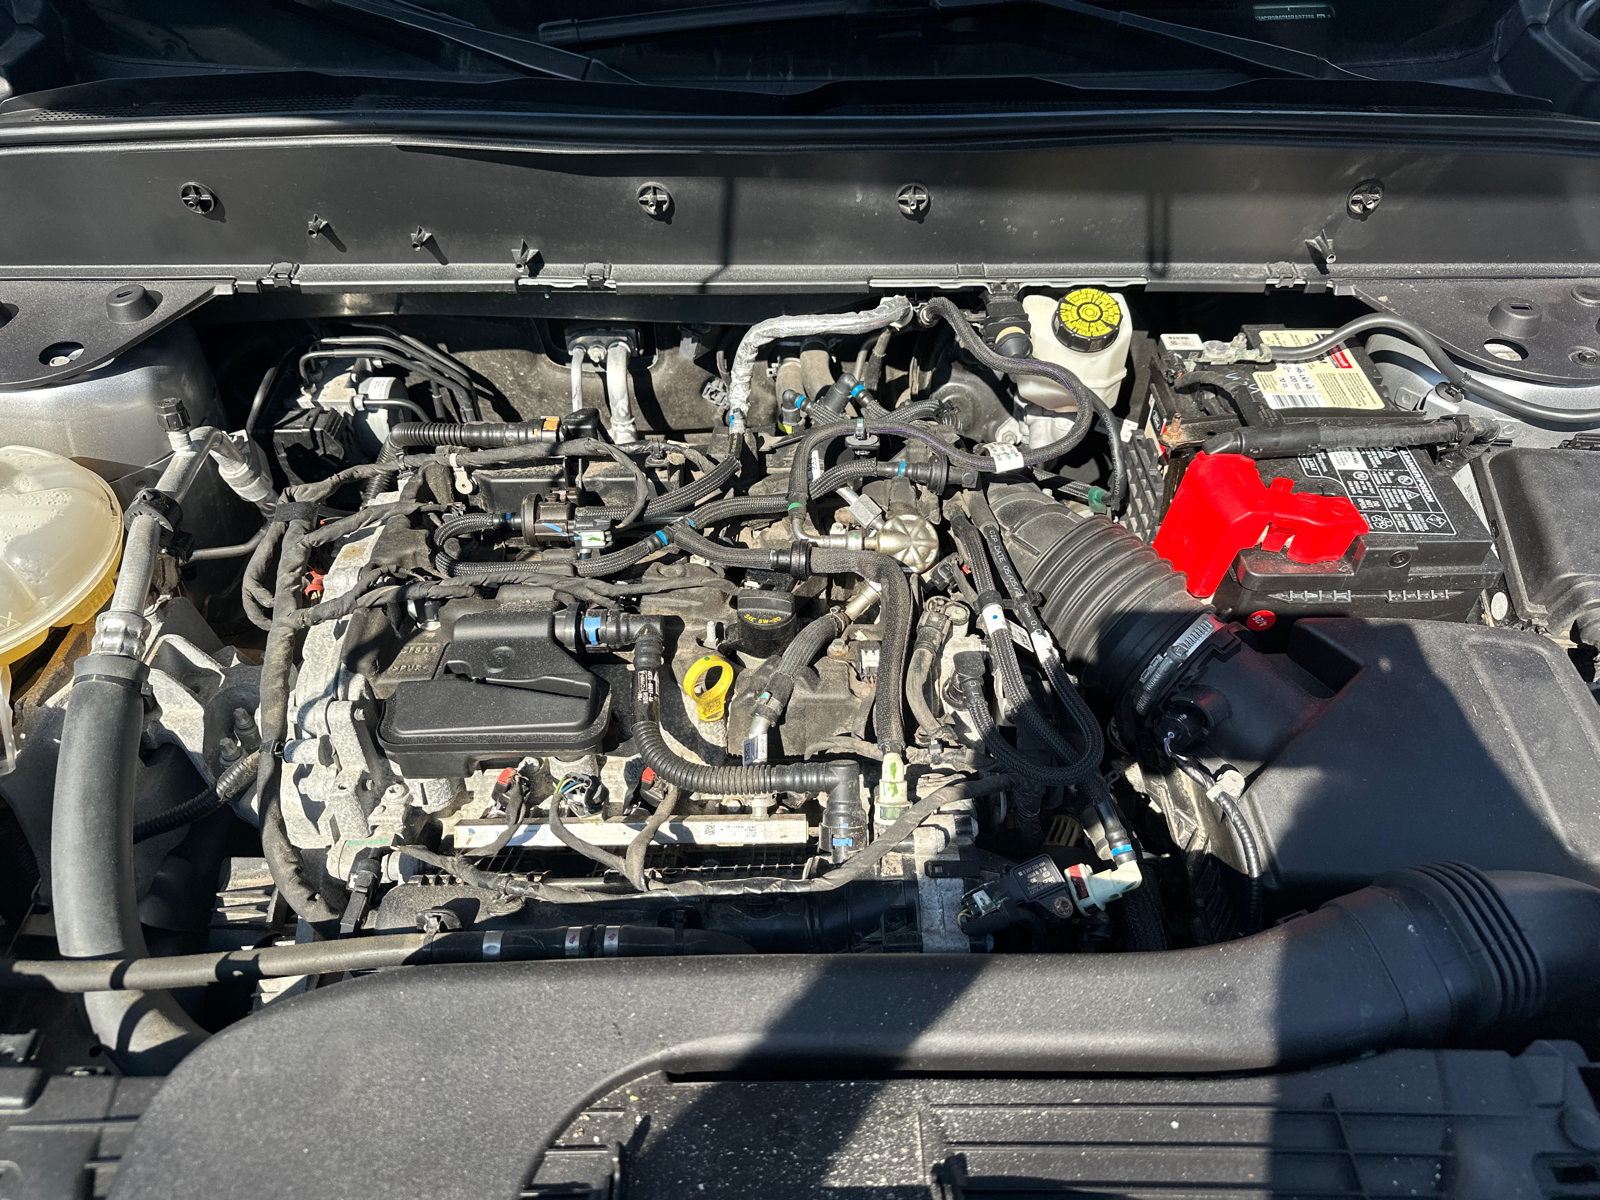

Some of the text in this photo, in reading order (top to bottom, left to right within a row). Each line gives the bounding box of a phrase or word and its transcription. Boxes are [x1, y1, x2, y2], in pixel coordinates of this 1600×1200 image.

[993, 545, 1006, 563] DATE
[1002, 565, 1022, 597] 05/05/2
[744, 613, 756, 622] SAE
